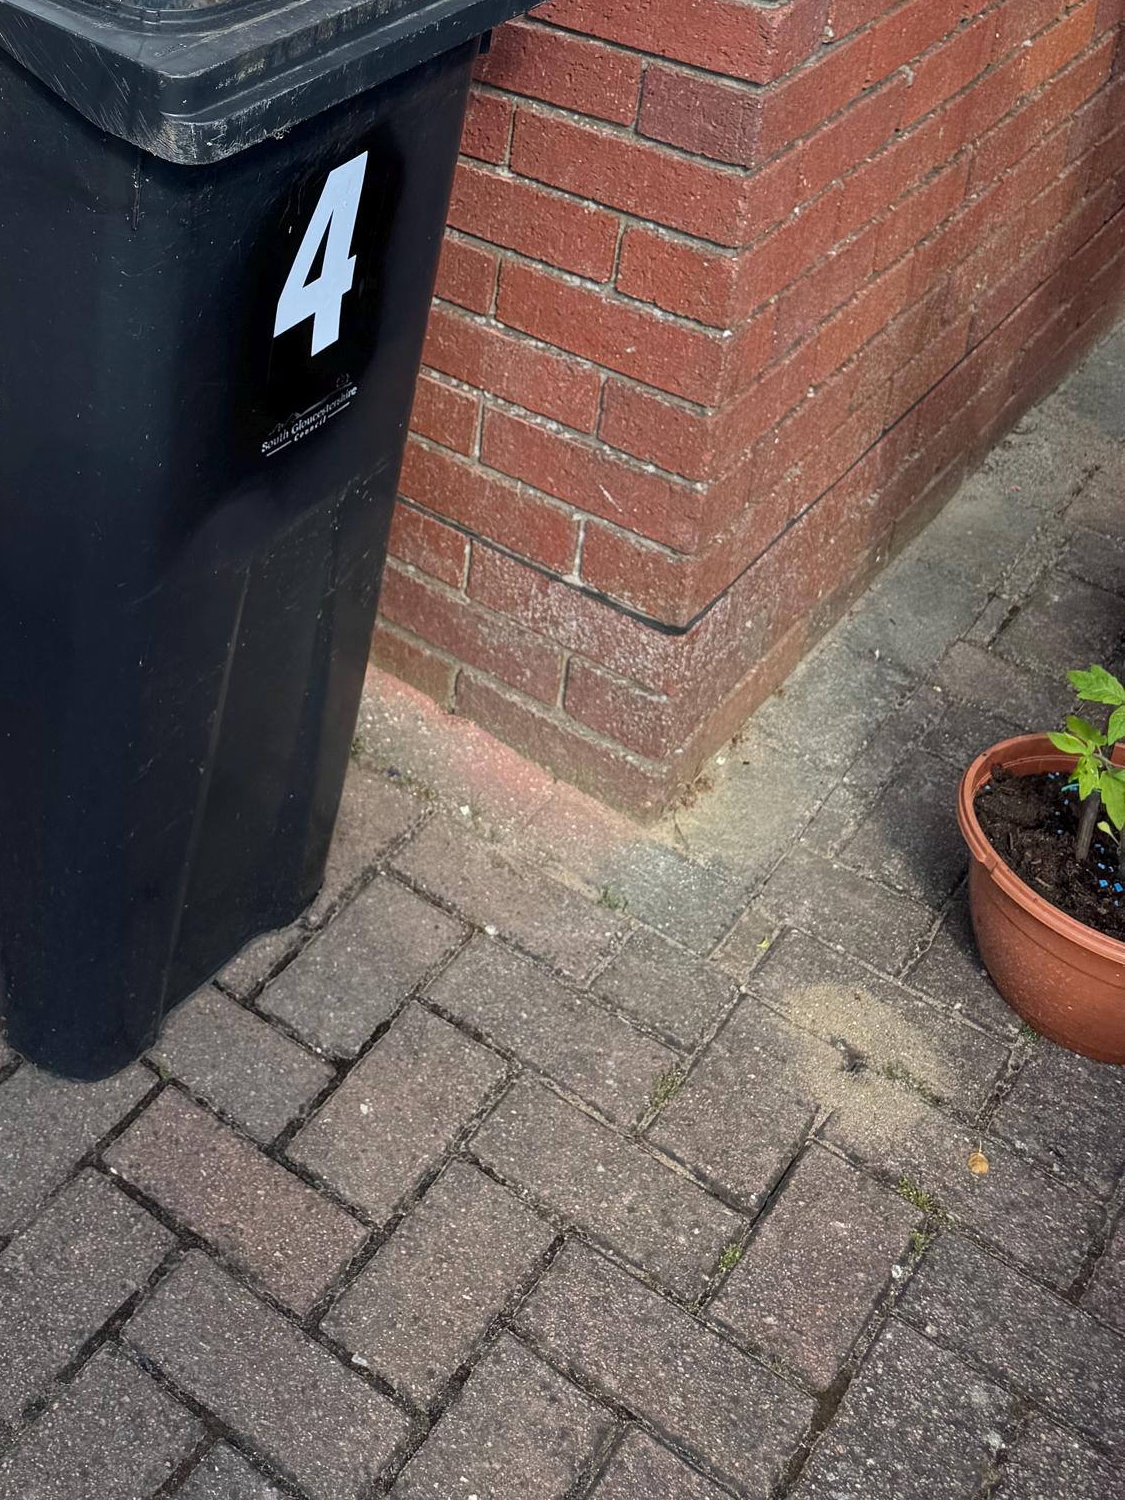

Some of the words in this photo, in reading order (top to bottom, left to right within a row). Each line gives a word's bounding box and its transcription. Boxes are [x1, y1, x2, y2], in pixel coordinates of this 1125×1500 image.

[273, 150, 368, 357] 4
[261, 428, 289, 453] South
[291, 386, 358, 435] Gloucestershire
[294, 415, 327, 442] Council
